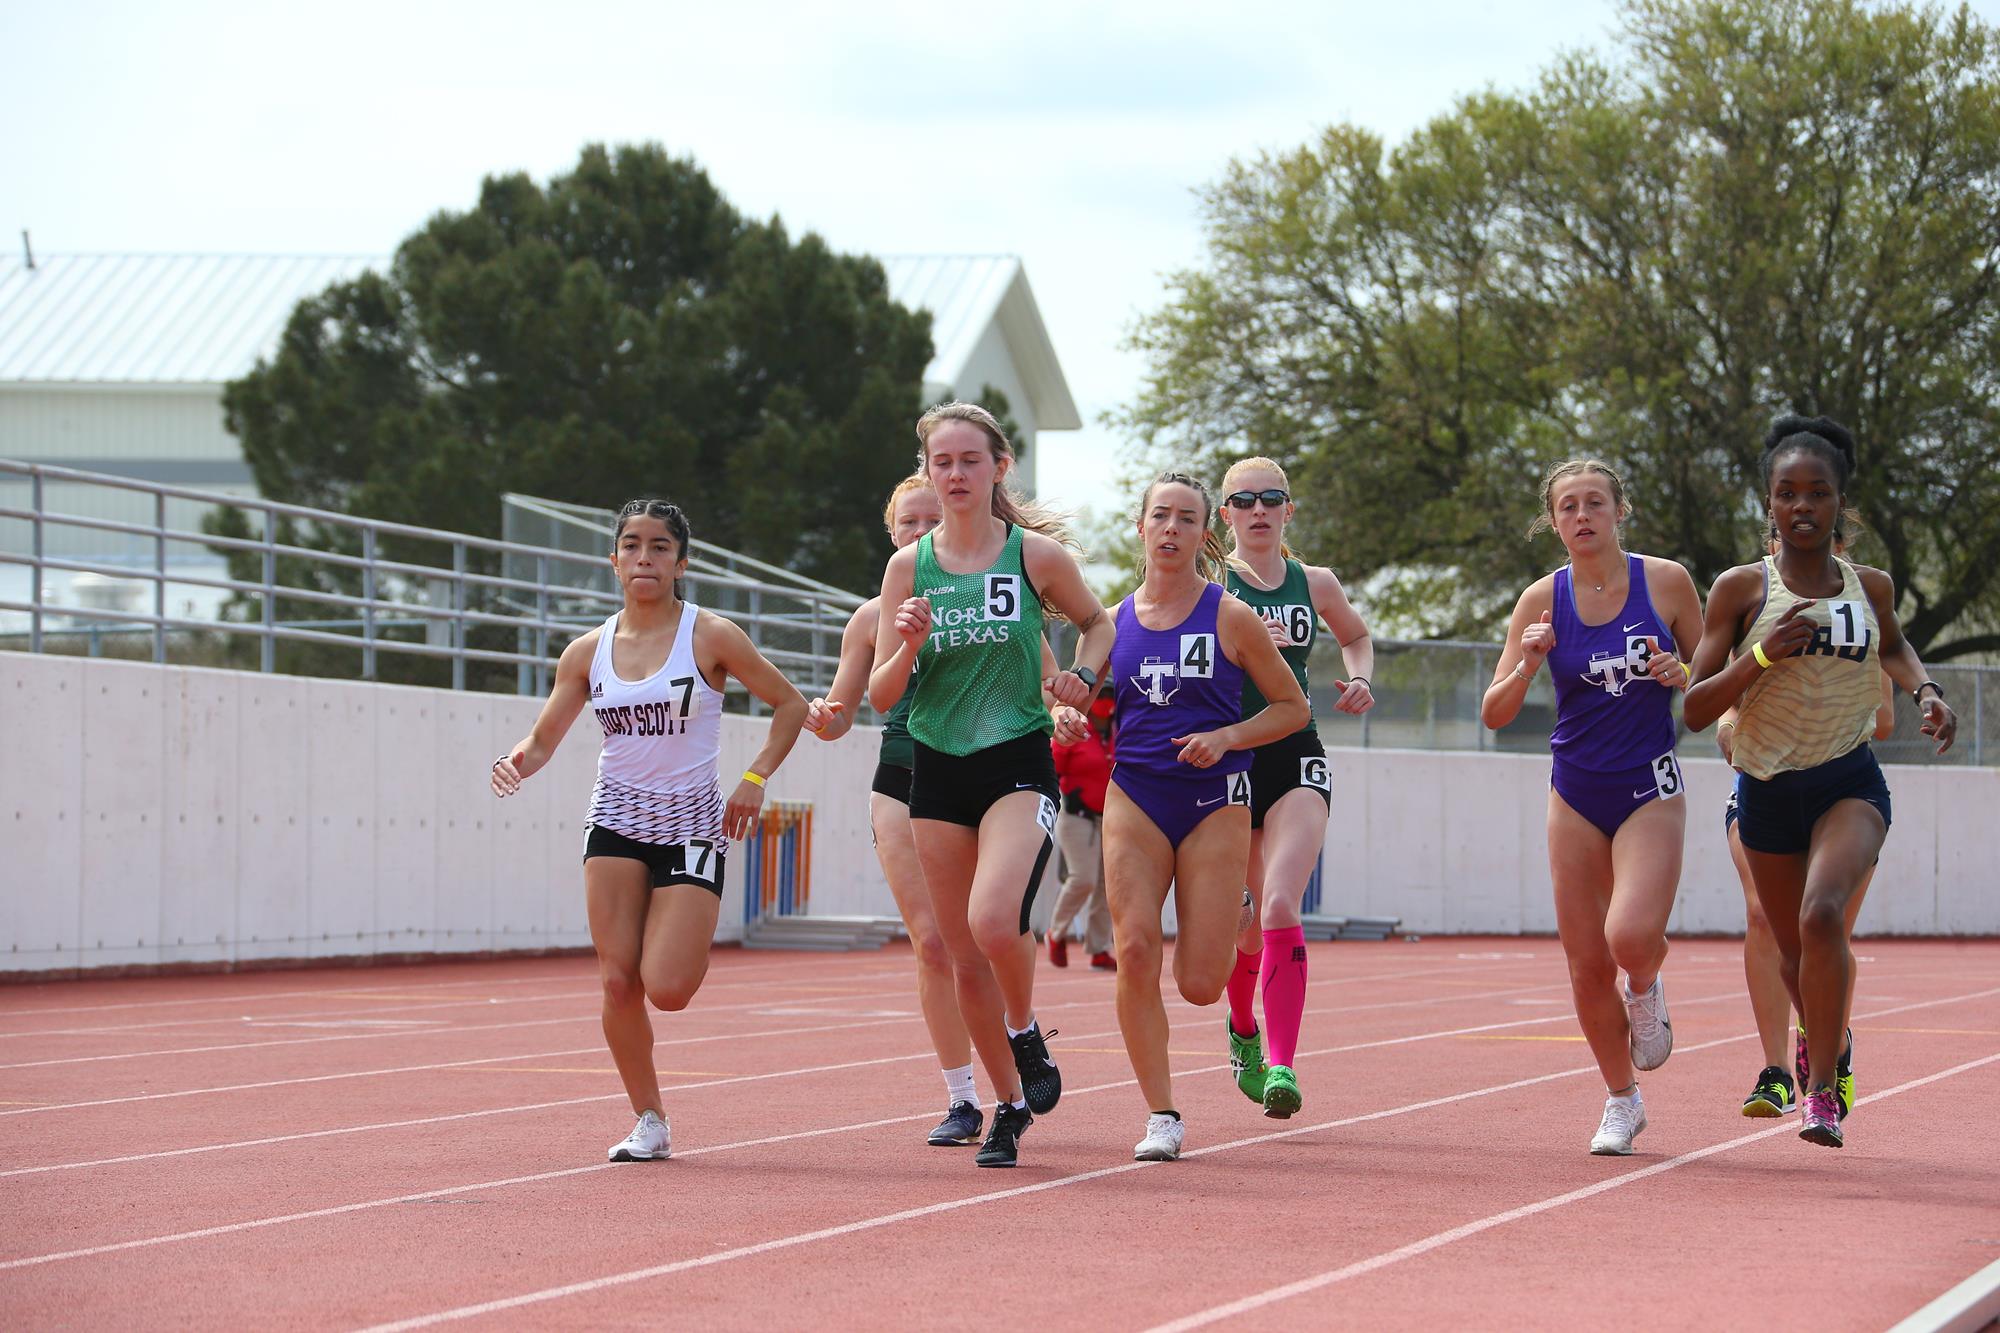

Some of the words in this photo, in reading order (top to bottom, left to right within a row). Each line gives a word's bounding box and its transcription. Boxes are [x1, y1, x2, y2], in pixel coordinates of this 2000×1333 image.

[989, 577, 1015, 617] 5
[929, 625, 1010, 653] TEXAS
[1290, 606, 1309, 643] 6
[1835, 603, 1855, 643] 1
[1184, 636, 1210, 675] 4
[1630, 638, 1651, 677] 3
[669, 676, 695, 717] 7
[1231, 771, 1250, 806] 4
[1305, 759, 1328, 785] 6
[1657, 756, 1679, 795] 3
[690, 839, 714, 875] 7
